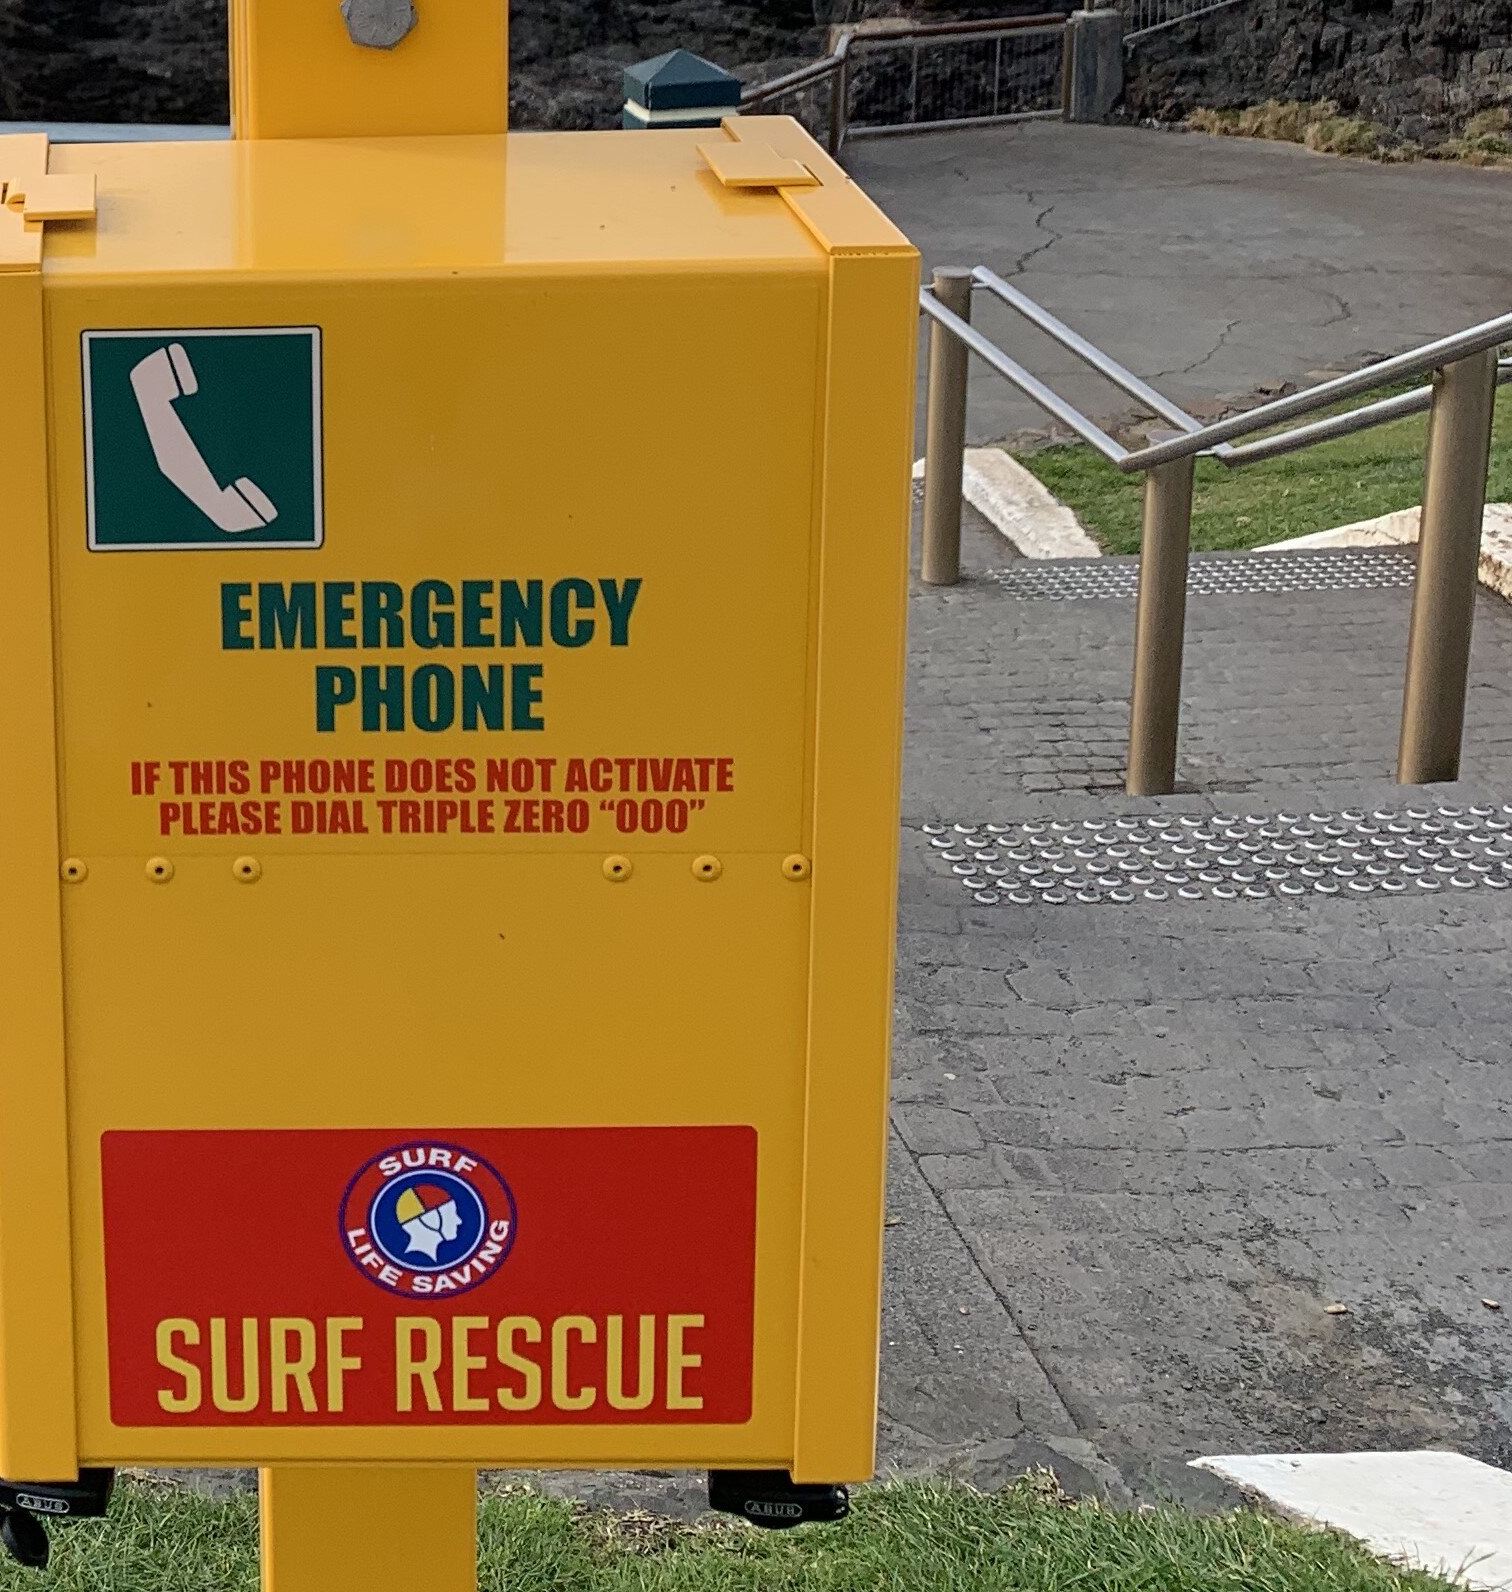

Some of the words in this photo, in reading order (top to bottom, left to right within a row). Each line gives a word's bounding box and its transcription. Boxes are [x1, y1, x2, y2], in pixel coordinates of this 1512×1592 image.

[220, 577, 643, 651] EMERGENCY
[315, 663, 545, 733] PHONE
[131, 761, 161, 796] IF
[168, 760, 251, 795] THIS
[260, 759, 376, 794] PHONE
[385, 758, 477, 794] DOES
[486, 757, 557, 793] NOT
[564, 757, 734, 793] ACTIVATE
[159, 800, 282, 836] PLEASE
[291, 800, 369, 835] DIAL
[376, 799, 495, 835] TRIPLE
[503, 798, 590, 834] ZERO
[379, 1148, 478, 1176] SURF
[347, 1228, 403, 1287] LIFE
[412, 1219, 510, 1293] SAVING
[155, 1317, 364, 1413] SURF
[395, 1314, 706, 1412] RESCUE
